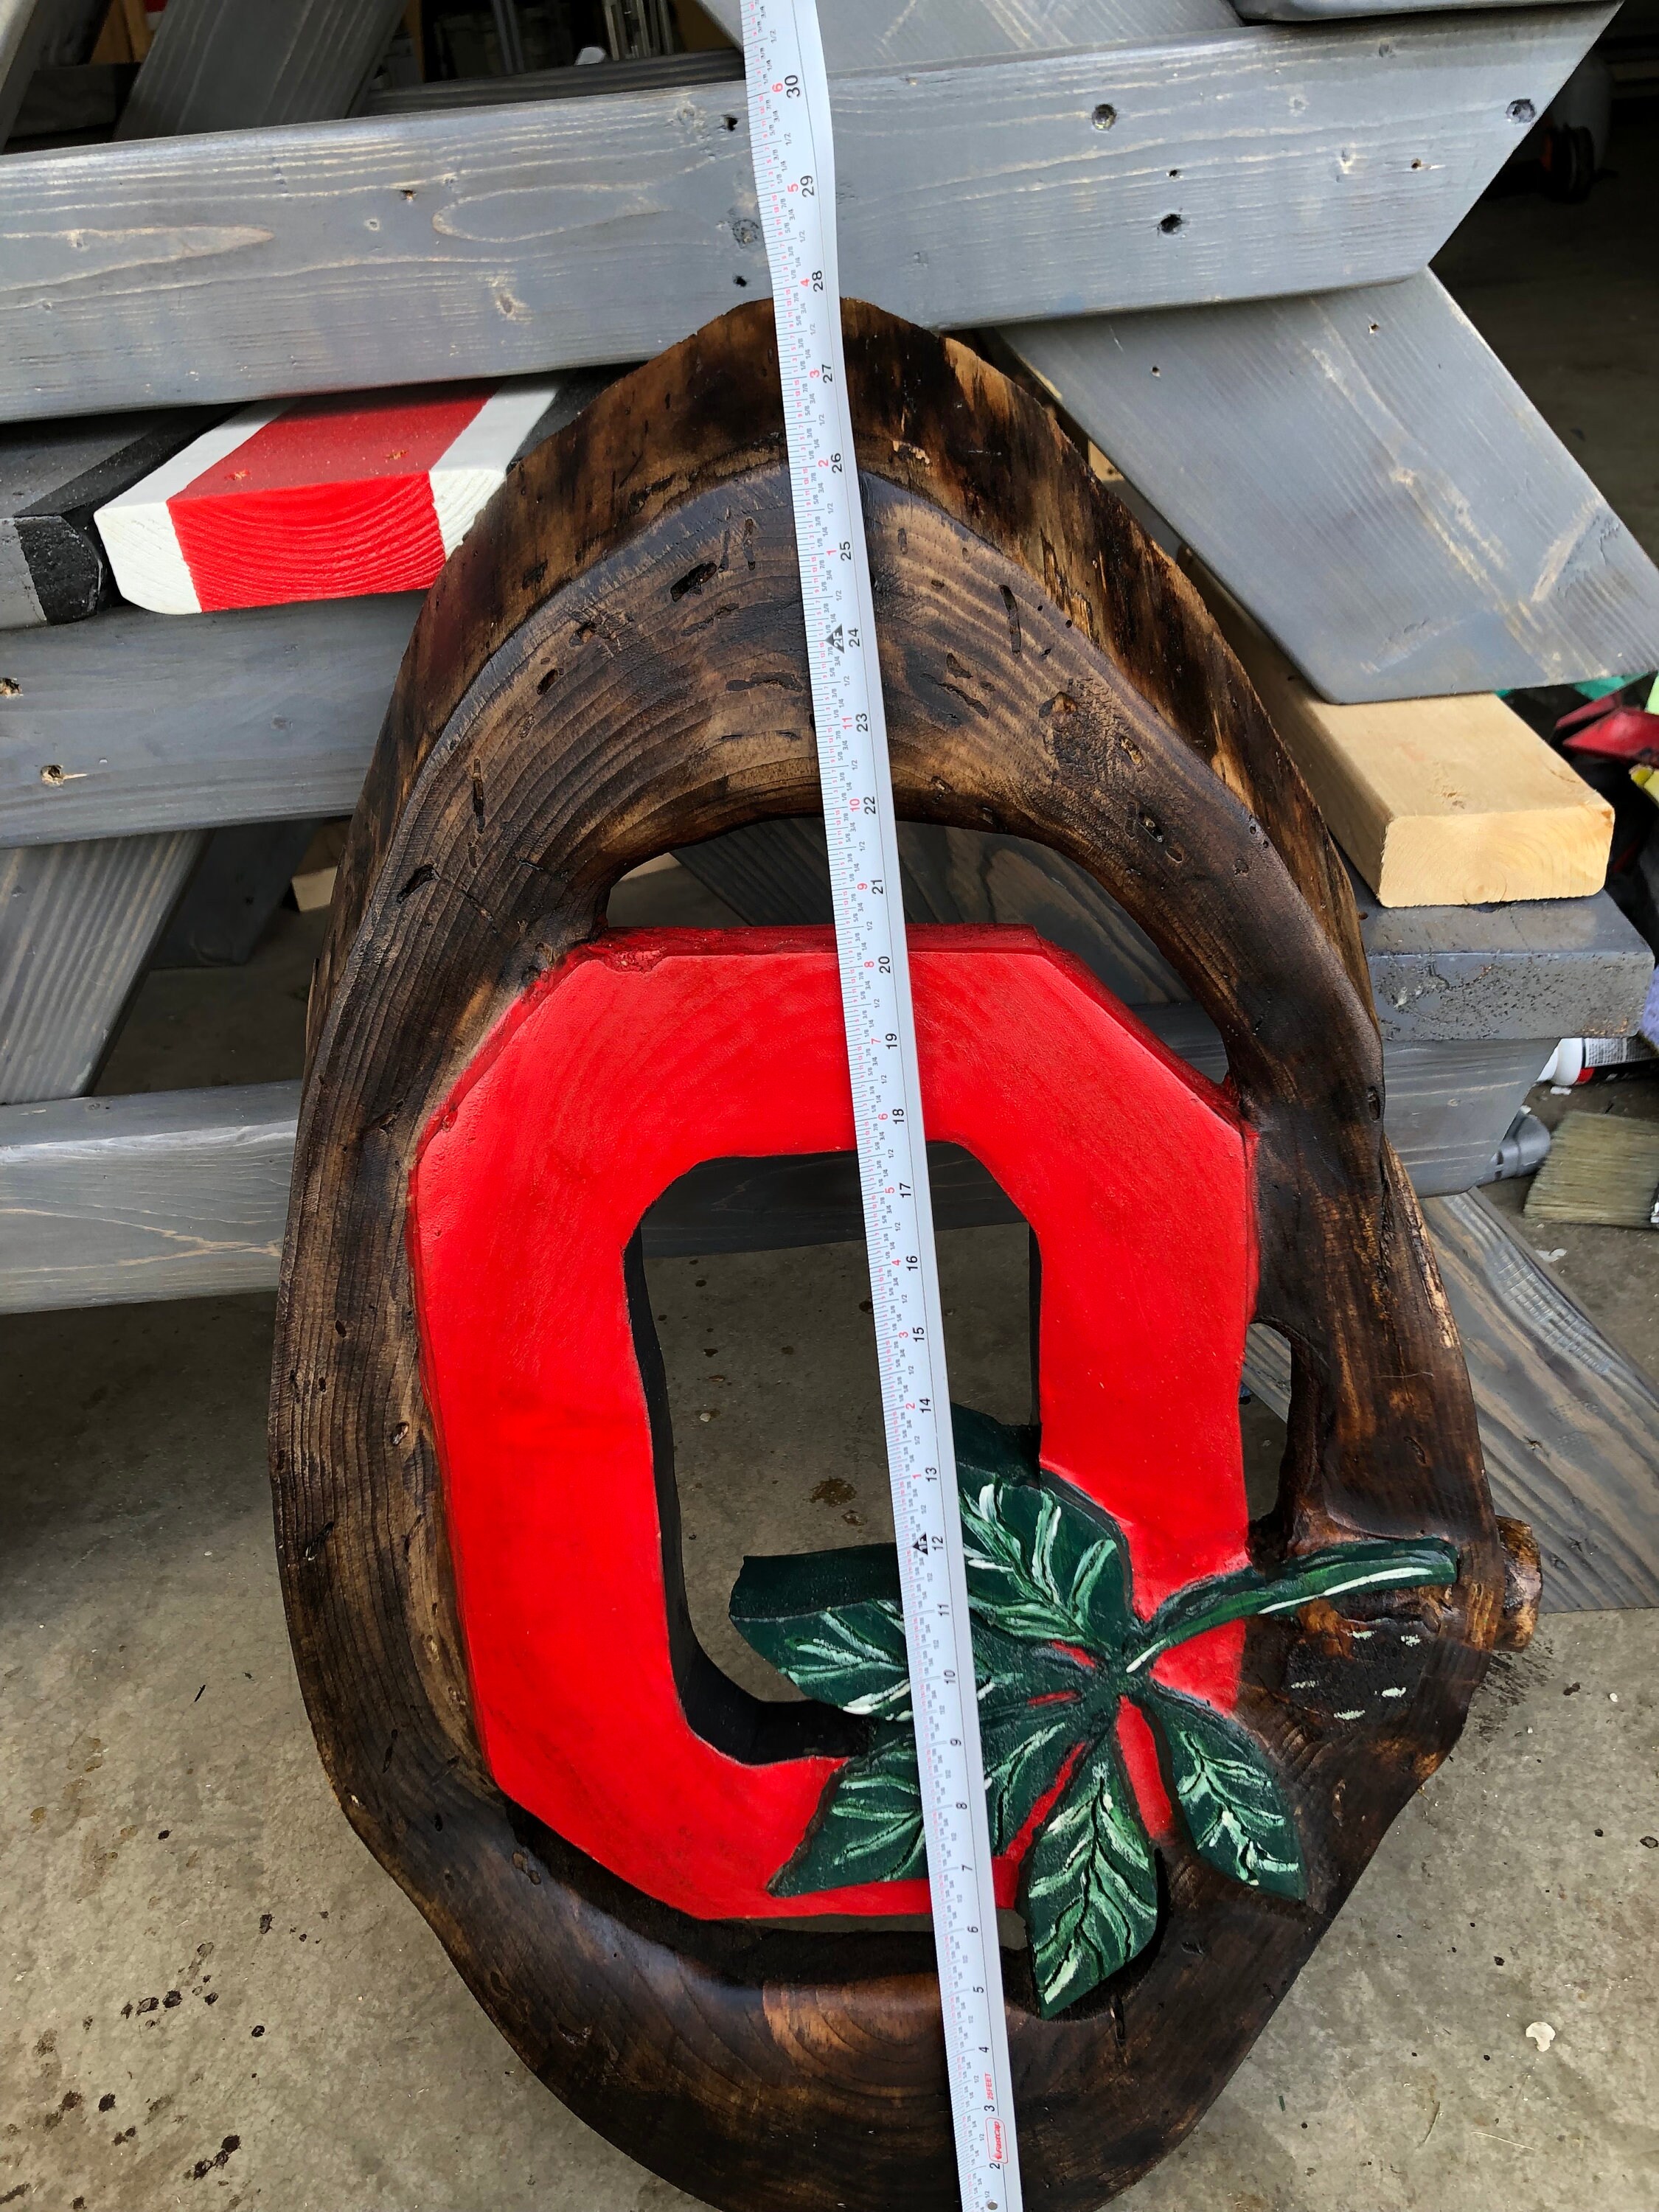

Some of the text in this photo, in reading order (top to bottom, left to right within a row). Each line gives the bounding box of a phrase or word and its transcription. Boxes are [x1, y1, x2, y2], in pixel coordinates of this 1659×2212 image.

[772, 83, 783, 93] 6
[785, 75, 800, 98] 30
[787, 183, 799, 192] 5
[800, 175, 814, 197] 29
[812, 271, 823, 292] 28
[809, 369, 820, 378] 3
[821, 364, 832, 383] 27
[831, 453, 842, 473] 26
[840, 541, 851, 560] 25
[849, 628, 860, 647] 24
[842, 717, 852, 729] 11
[856, 714, 868, 731] 23
[849, 798, 860, 812] 10
[863, 796, 876, 814] 22
[871, 880, 883, 894] 21
[878, 956, 891, 973] 20
[886, 1034, 897, 1049] 19
[878, 1113, 888, 1121] 6
[892, 1109, 904, 1124] 18
[900, 1183, 911, 1197] 17
[906, 1256, 918, 1271] 16
[913, 1327, 925, 1342] 15
[919, 1399, 931, 1413] 14
[925, 1468, 937, 1482] 13
[932, 1537, 943, 1551] 12
[938, 1605, 949, 1616] 11
[944, 1670, 956, 1684] 10
